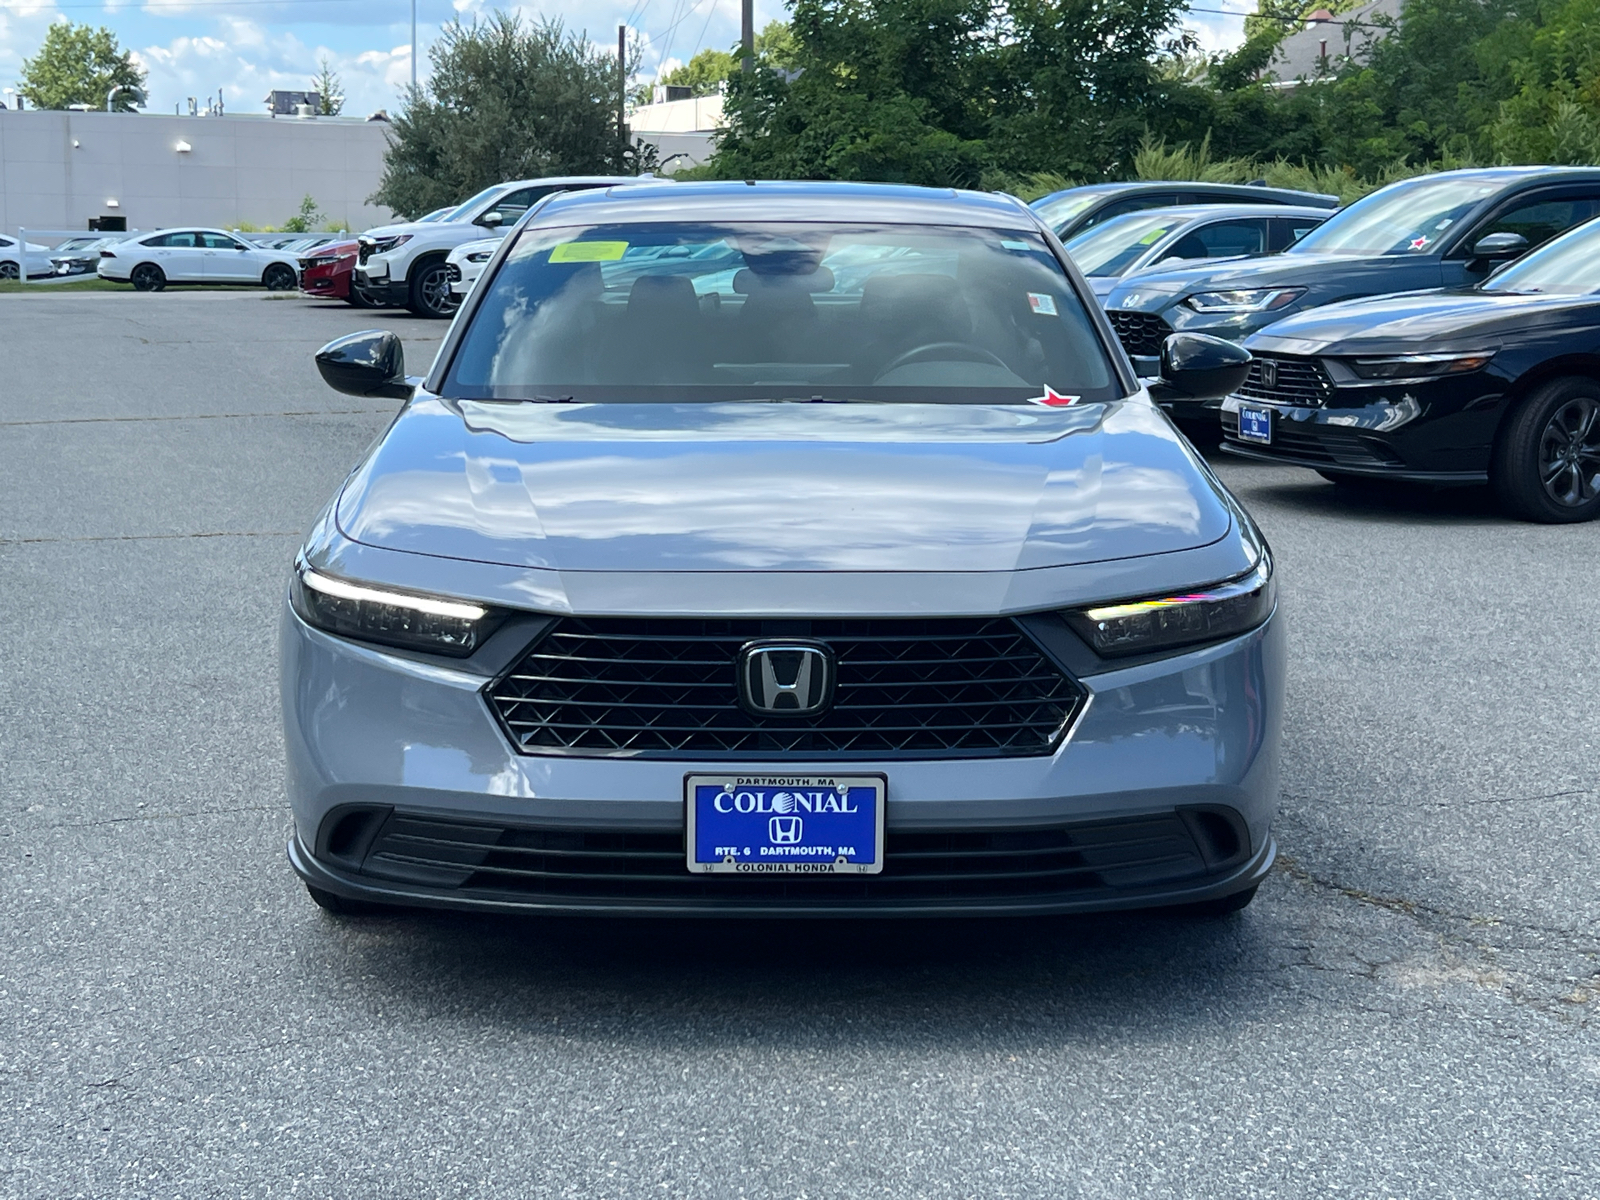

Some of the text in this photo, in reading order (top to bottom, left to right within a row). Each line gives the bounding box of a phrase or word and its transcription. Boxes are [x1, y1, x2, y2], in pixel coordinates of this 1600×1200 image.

[736, 777, 835, 787] DARTMOUTH, MA
[714, 791, 858, 814] COLONIAL
[714, 846, 856, 857] RTE. 6 DARTMOUTH, MA
[735, 863, 835, 872] COLONIAL HONDA
